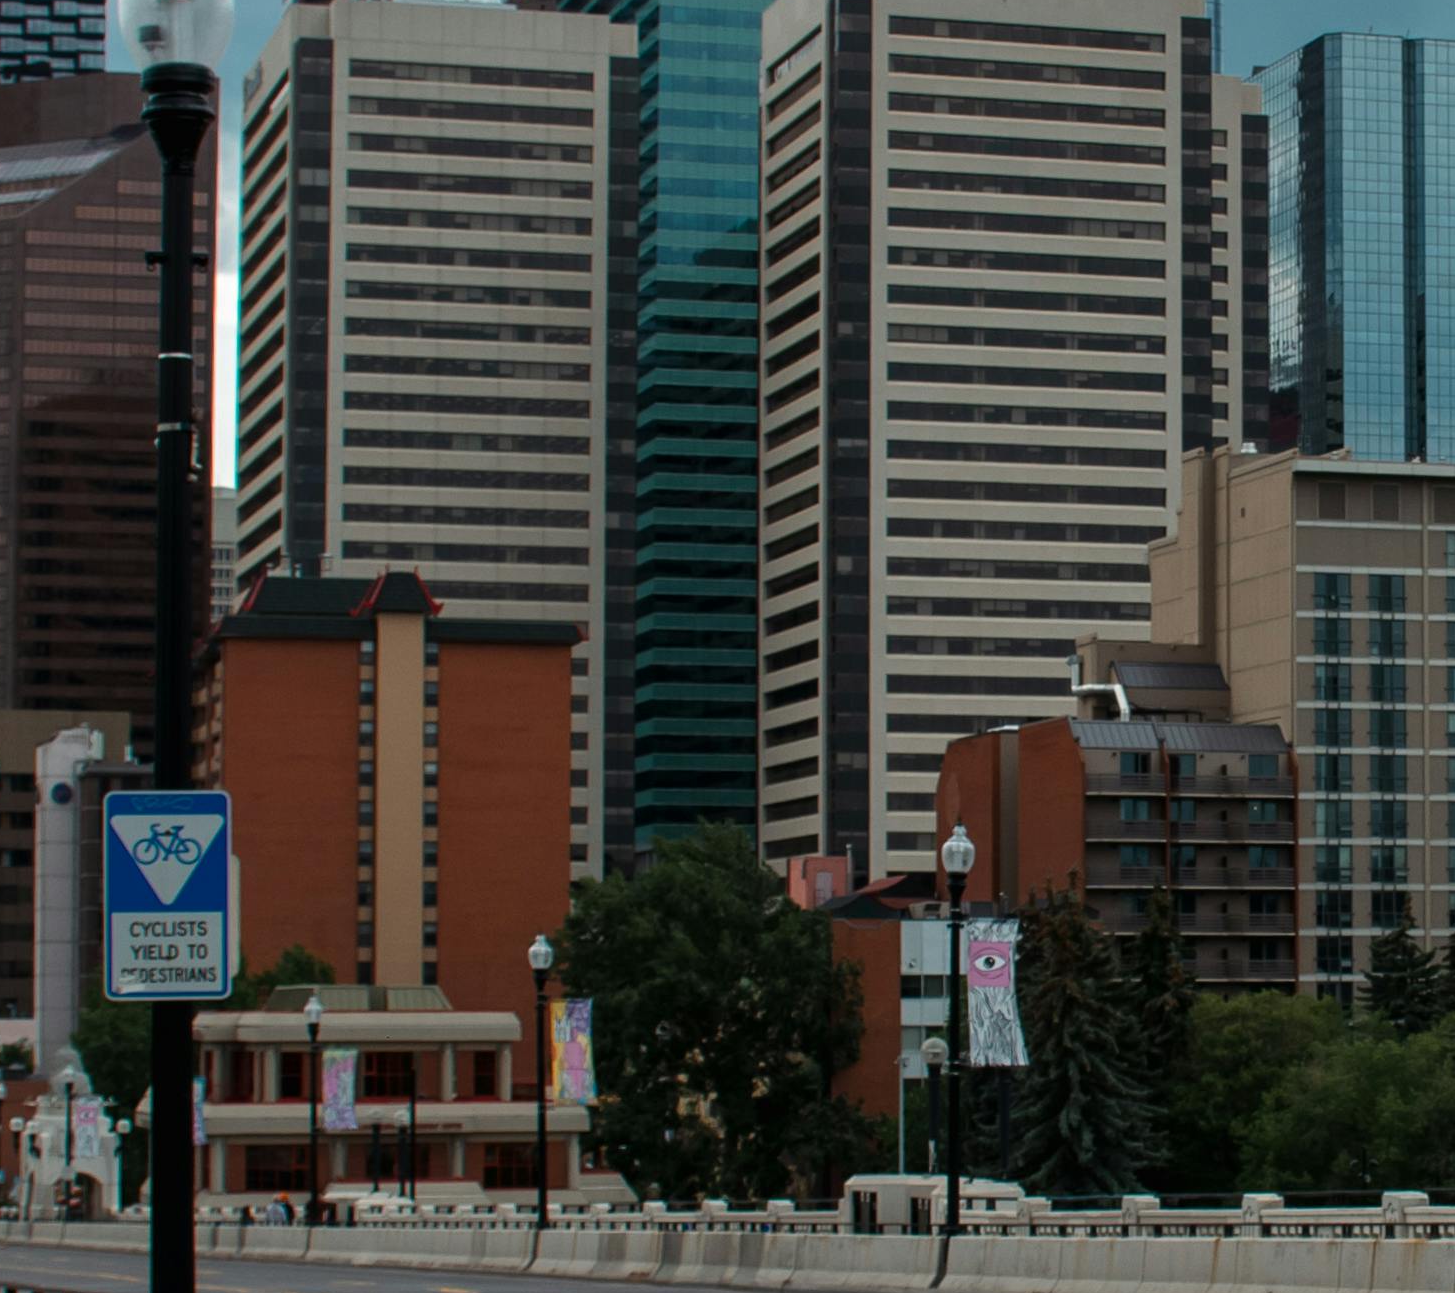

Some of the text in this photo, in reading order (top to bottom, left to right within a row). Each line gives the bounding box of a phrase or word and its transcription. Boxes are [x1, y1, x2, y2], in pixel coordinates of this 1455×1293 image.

[129, 921, 208, 938] CYCLISTS
[130, 943, 209, 961] YIELD TO
